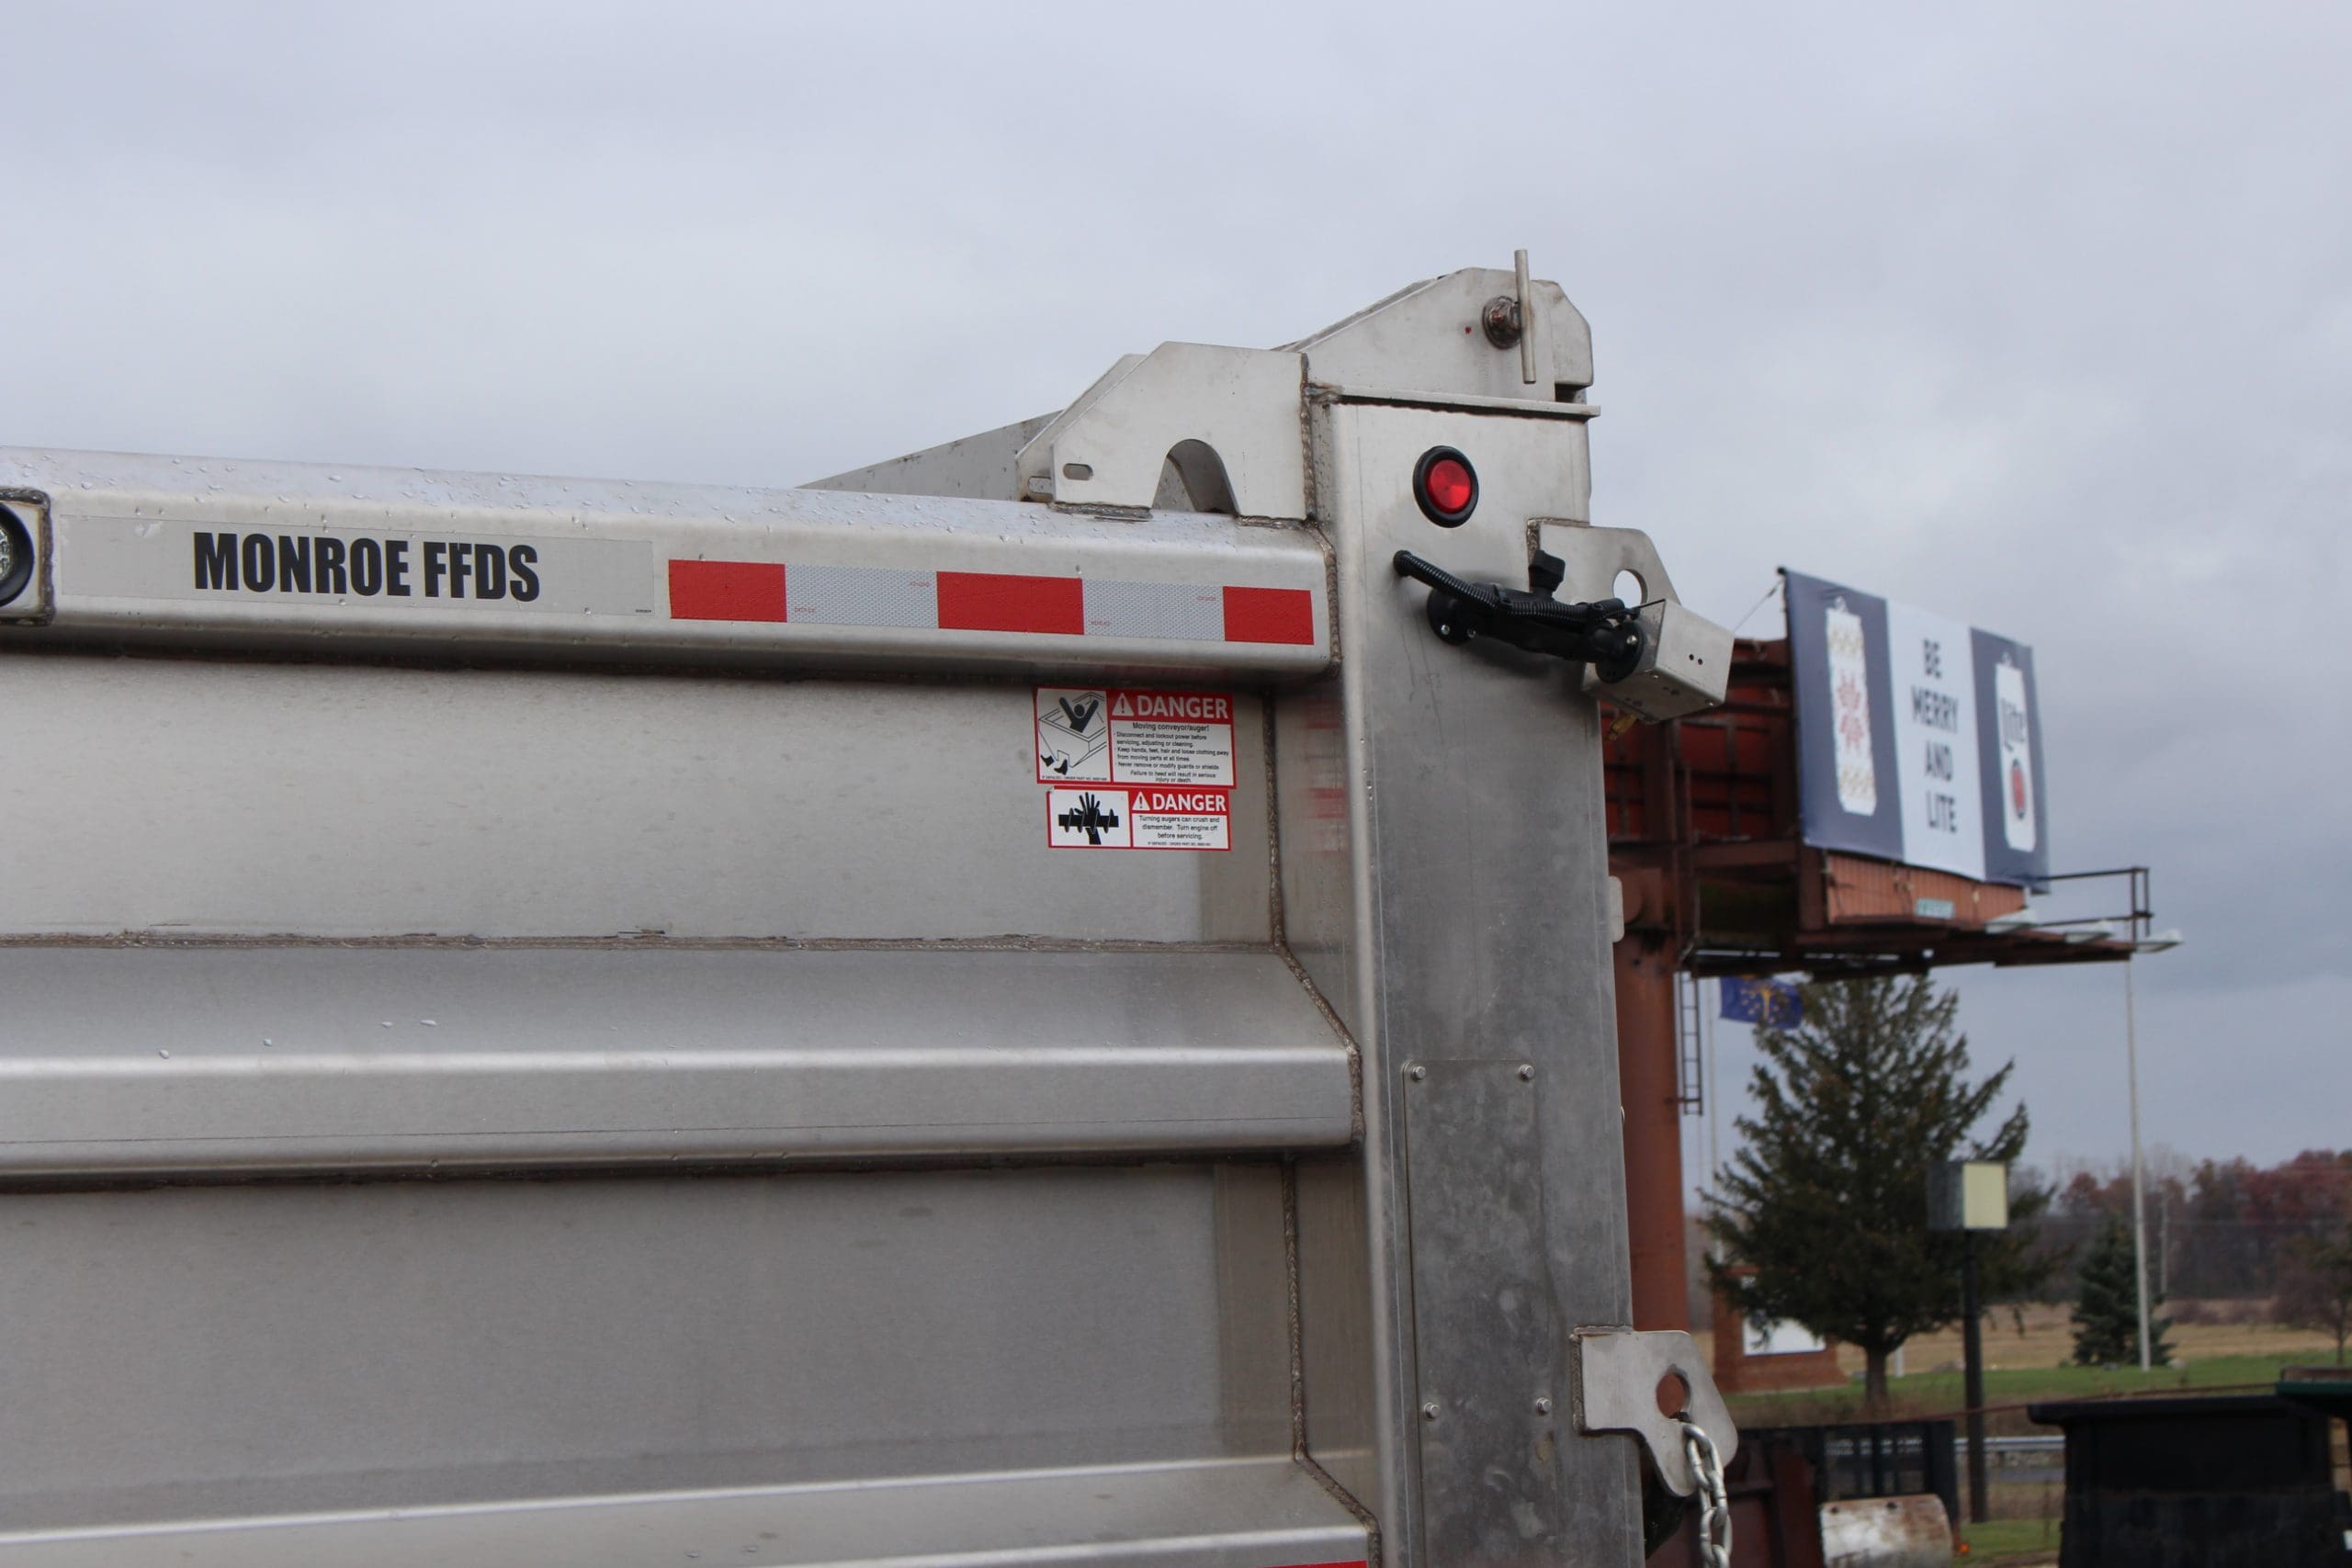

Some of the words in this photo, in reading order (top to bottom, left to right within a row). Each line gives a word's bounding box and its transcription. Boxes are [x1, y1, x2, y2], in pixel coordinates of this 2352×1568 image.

[194, 532, 411, 596] MONROE
[424, 541, 540, 602] FFDS
[1923, 639, 1942, 679] BE
[1137, 695, 1228, 719] DANGER
[1911, 685, 1958, 734] MERRY
[1158, 724, 1209, 732] conveyor/auger!
[1925, 739, 1953, 782] AND
[1152, 794, 1227, 811] DANGER
[1926, 791, 1957, 833] LITE
